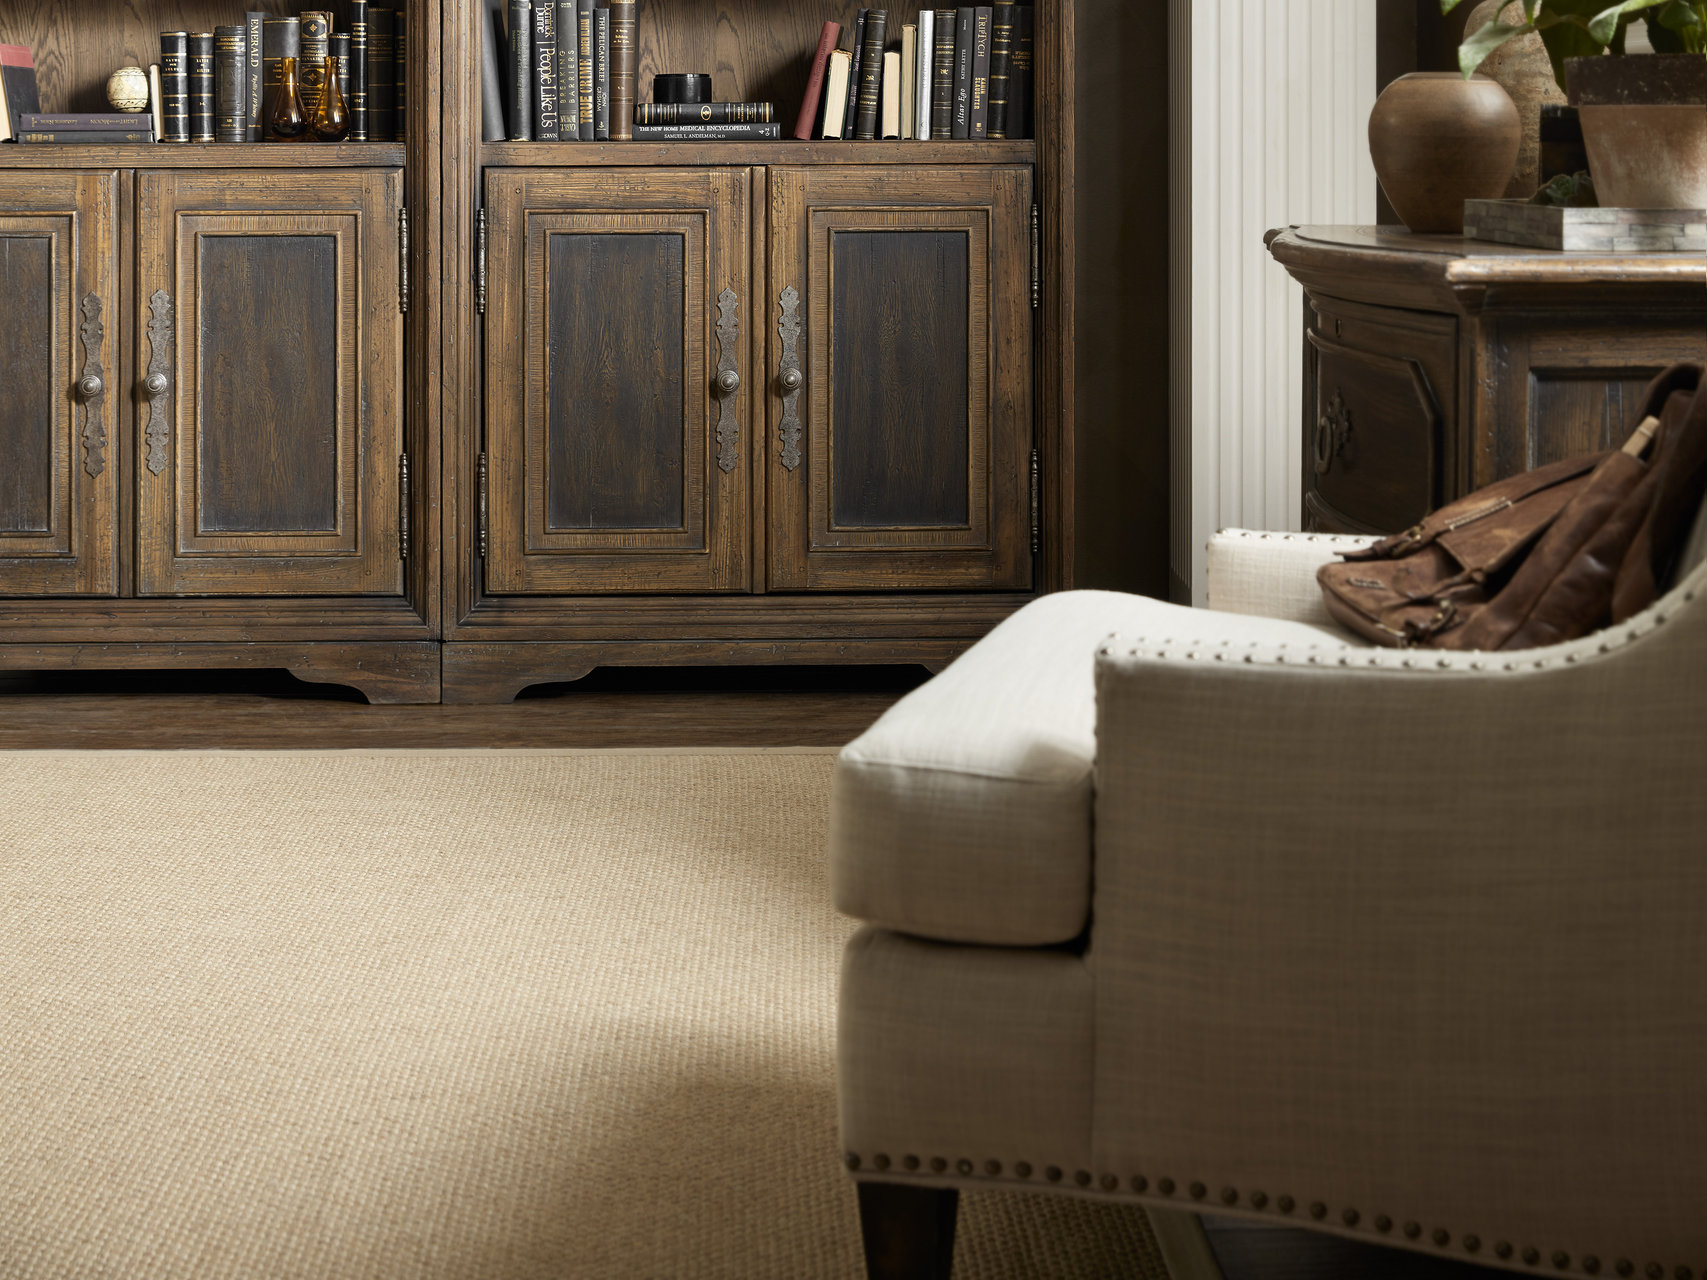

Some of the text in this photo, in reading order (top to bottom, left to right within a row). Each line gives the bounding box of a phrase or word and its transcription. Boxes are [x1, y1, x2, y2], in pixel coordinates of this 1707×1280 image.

[535, 7, 545, 34] Dunne
[544, 2, 555, 38] Dominick
[250, 18, 259, 68] EMERALD
[598, 31, 606, 62] PELICAN
[537, 47, 557, 128] People Like Us
[559, 50, 567, 104] BREAKING
[568, 50, 576, 104] BARRIERS
[579, 58, 593, 94] CRIME
[598, 63, 606, 83] BRIEF
[579, 95, 593, 124] TRUE
[957, 88, 968, 102] Ego
[973, 77, 981, 110] SLAUGHTER
[957, 103, 966, 125] Altar
